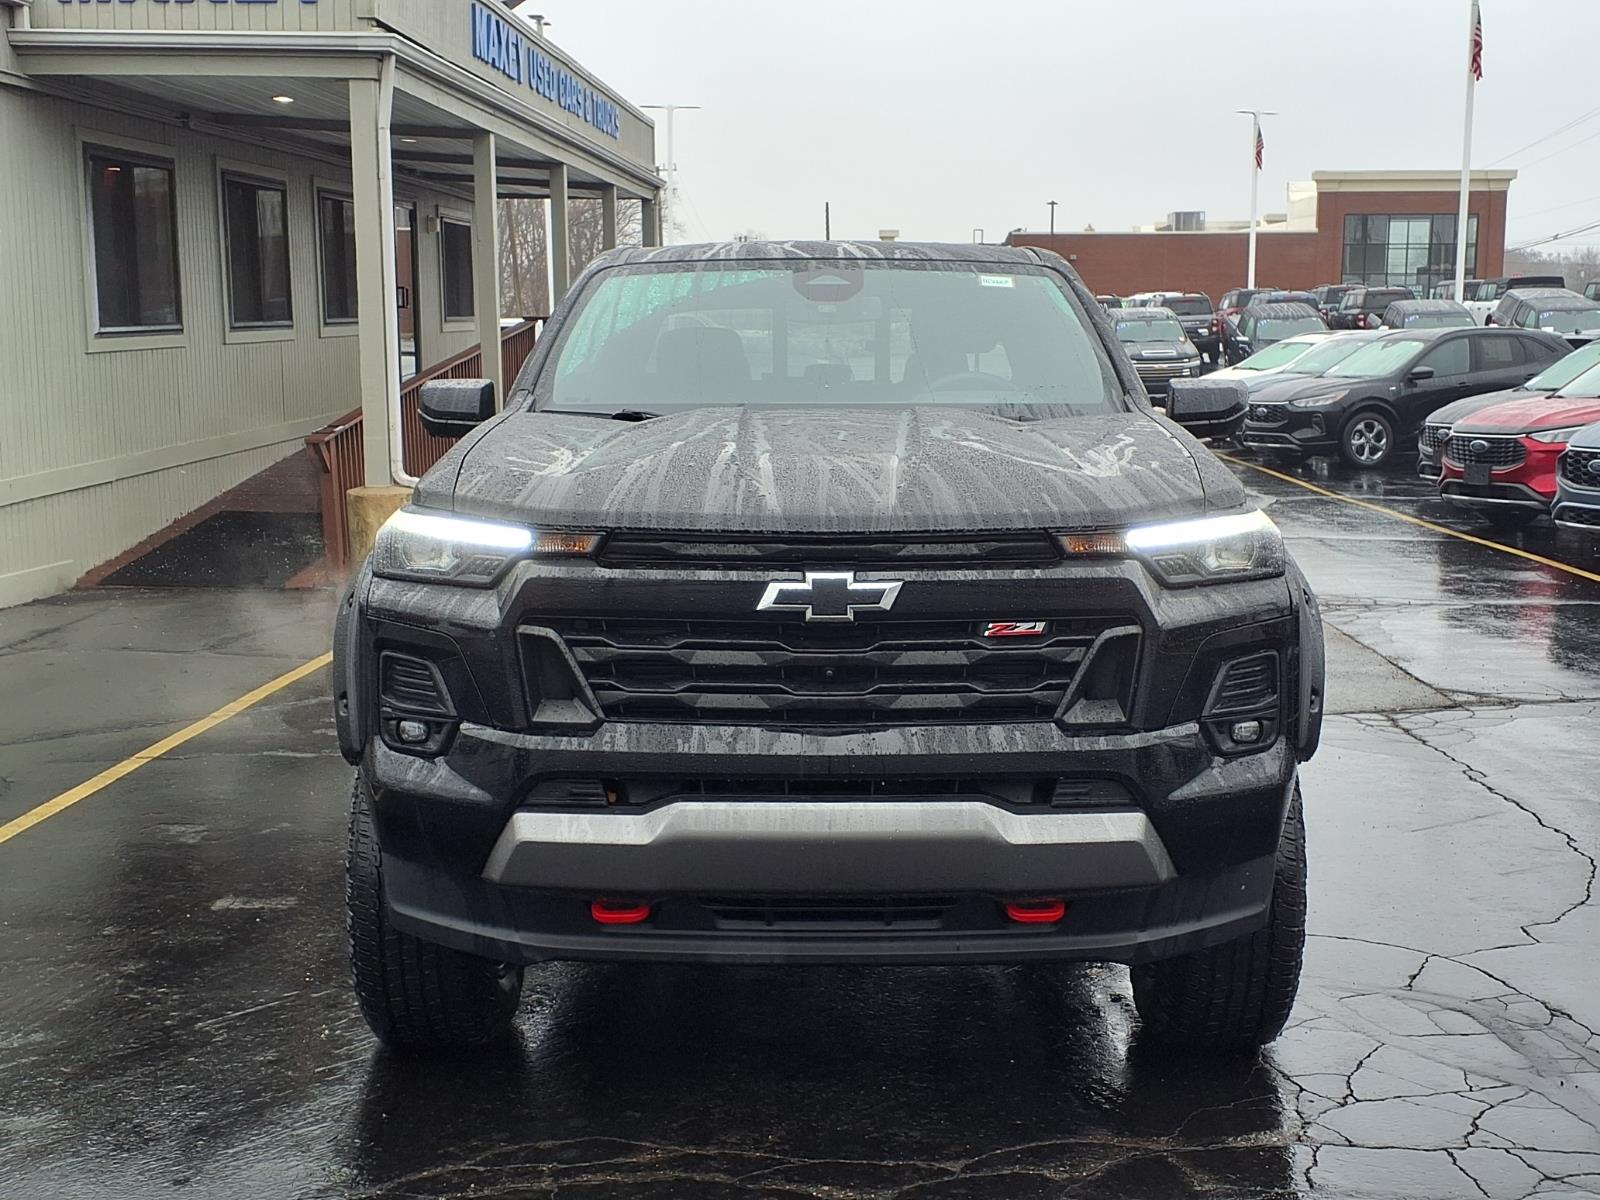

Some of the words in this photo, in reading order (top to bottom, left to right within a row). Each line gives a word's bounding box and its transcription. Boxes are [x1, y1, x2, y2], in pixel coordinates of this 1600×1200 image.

[471, 3, 525, 85] MAXEY
[528, 47, 559, 102] USED
[558, 69, 583, 118] CARS
[584, 87, 592, 123] &
[591, 91, 620, 140] TRUCKS
[983, 621, 1047, 638] Z71
